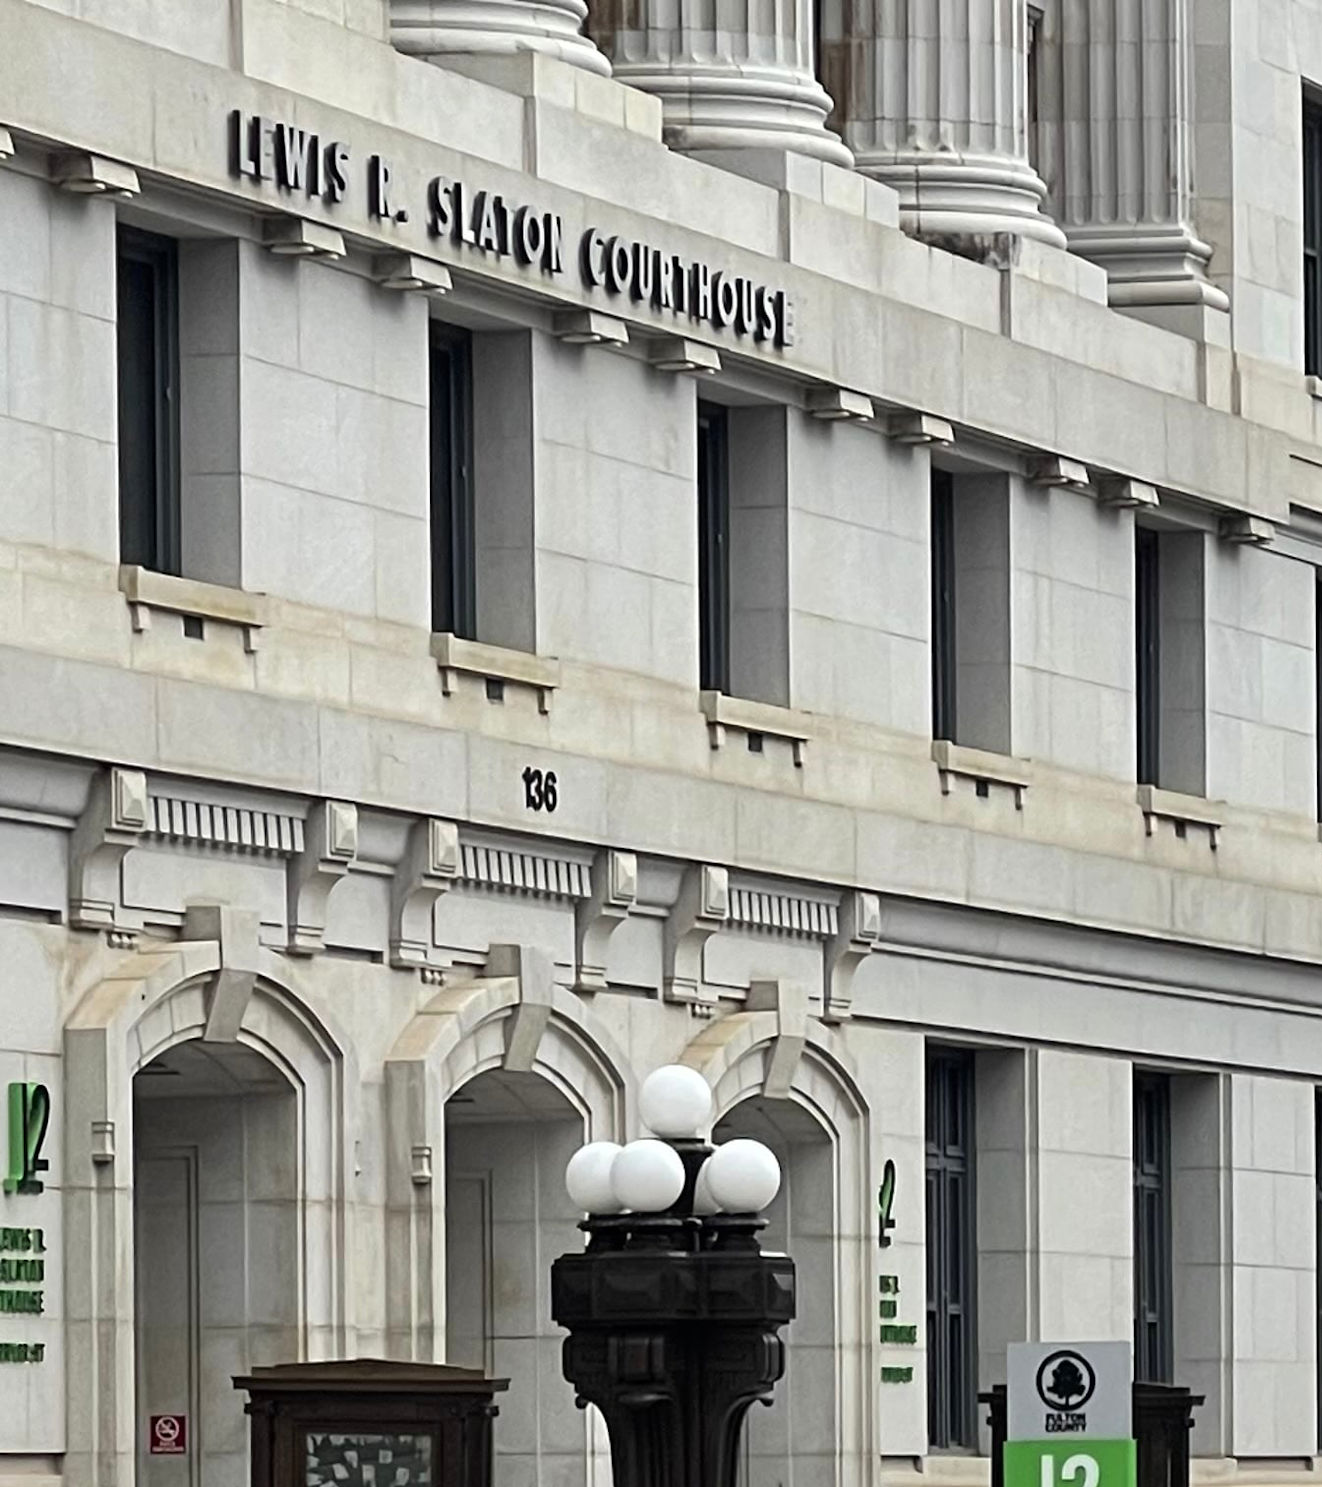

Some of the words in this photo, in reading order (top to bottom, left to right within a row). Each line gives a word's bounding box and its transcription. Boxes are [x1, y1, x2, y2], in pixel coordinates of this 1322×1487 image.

[228, 110, 348, 203] LEWIS
[427, 175, 562, 274] SLATON
[579, 227, 796, 348] COURTHOUSE
[522, 766, 557, 813] 136
[1045, 1413, 1086, 1424] FULTON
[1045, 1423, 1087, 1433] COUNTY
